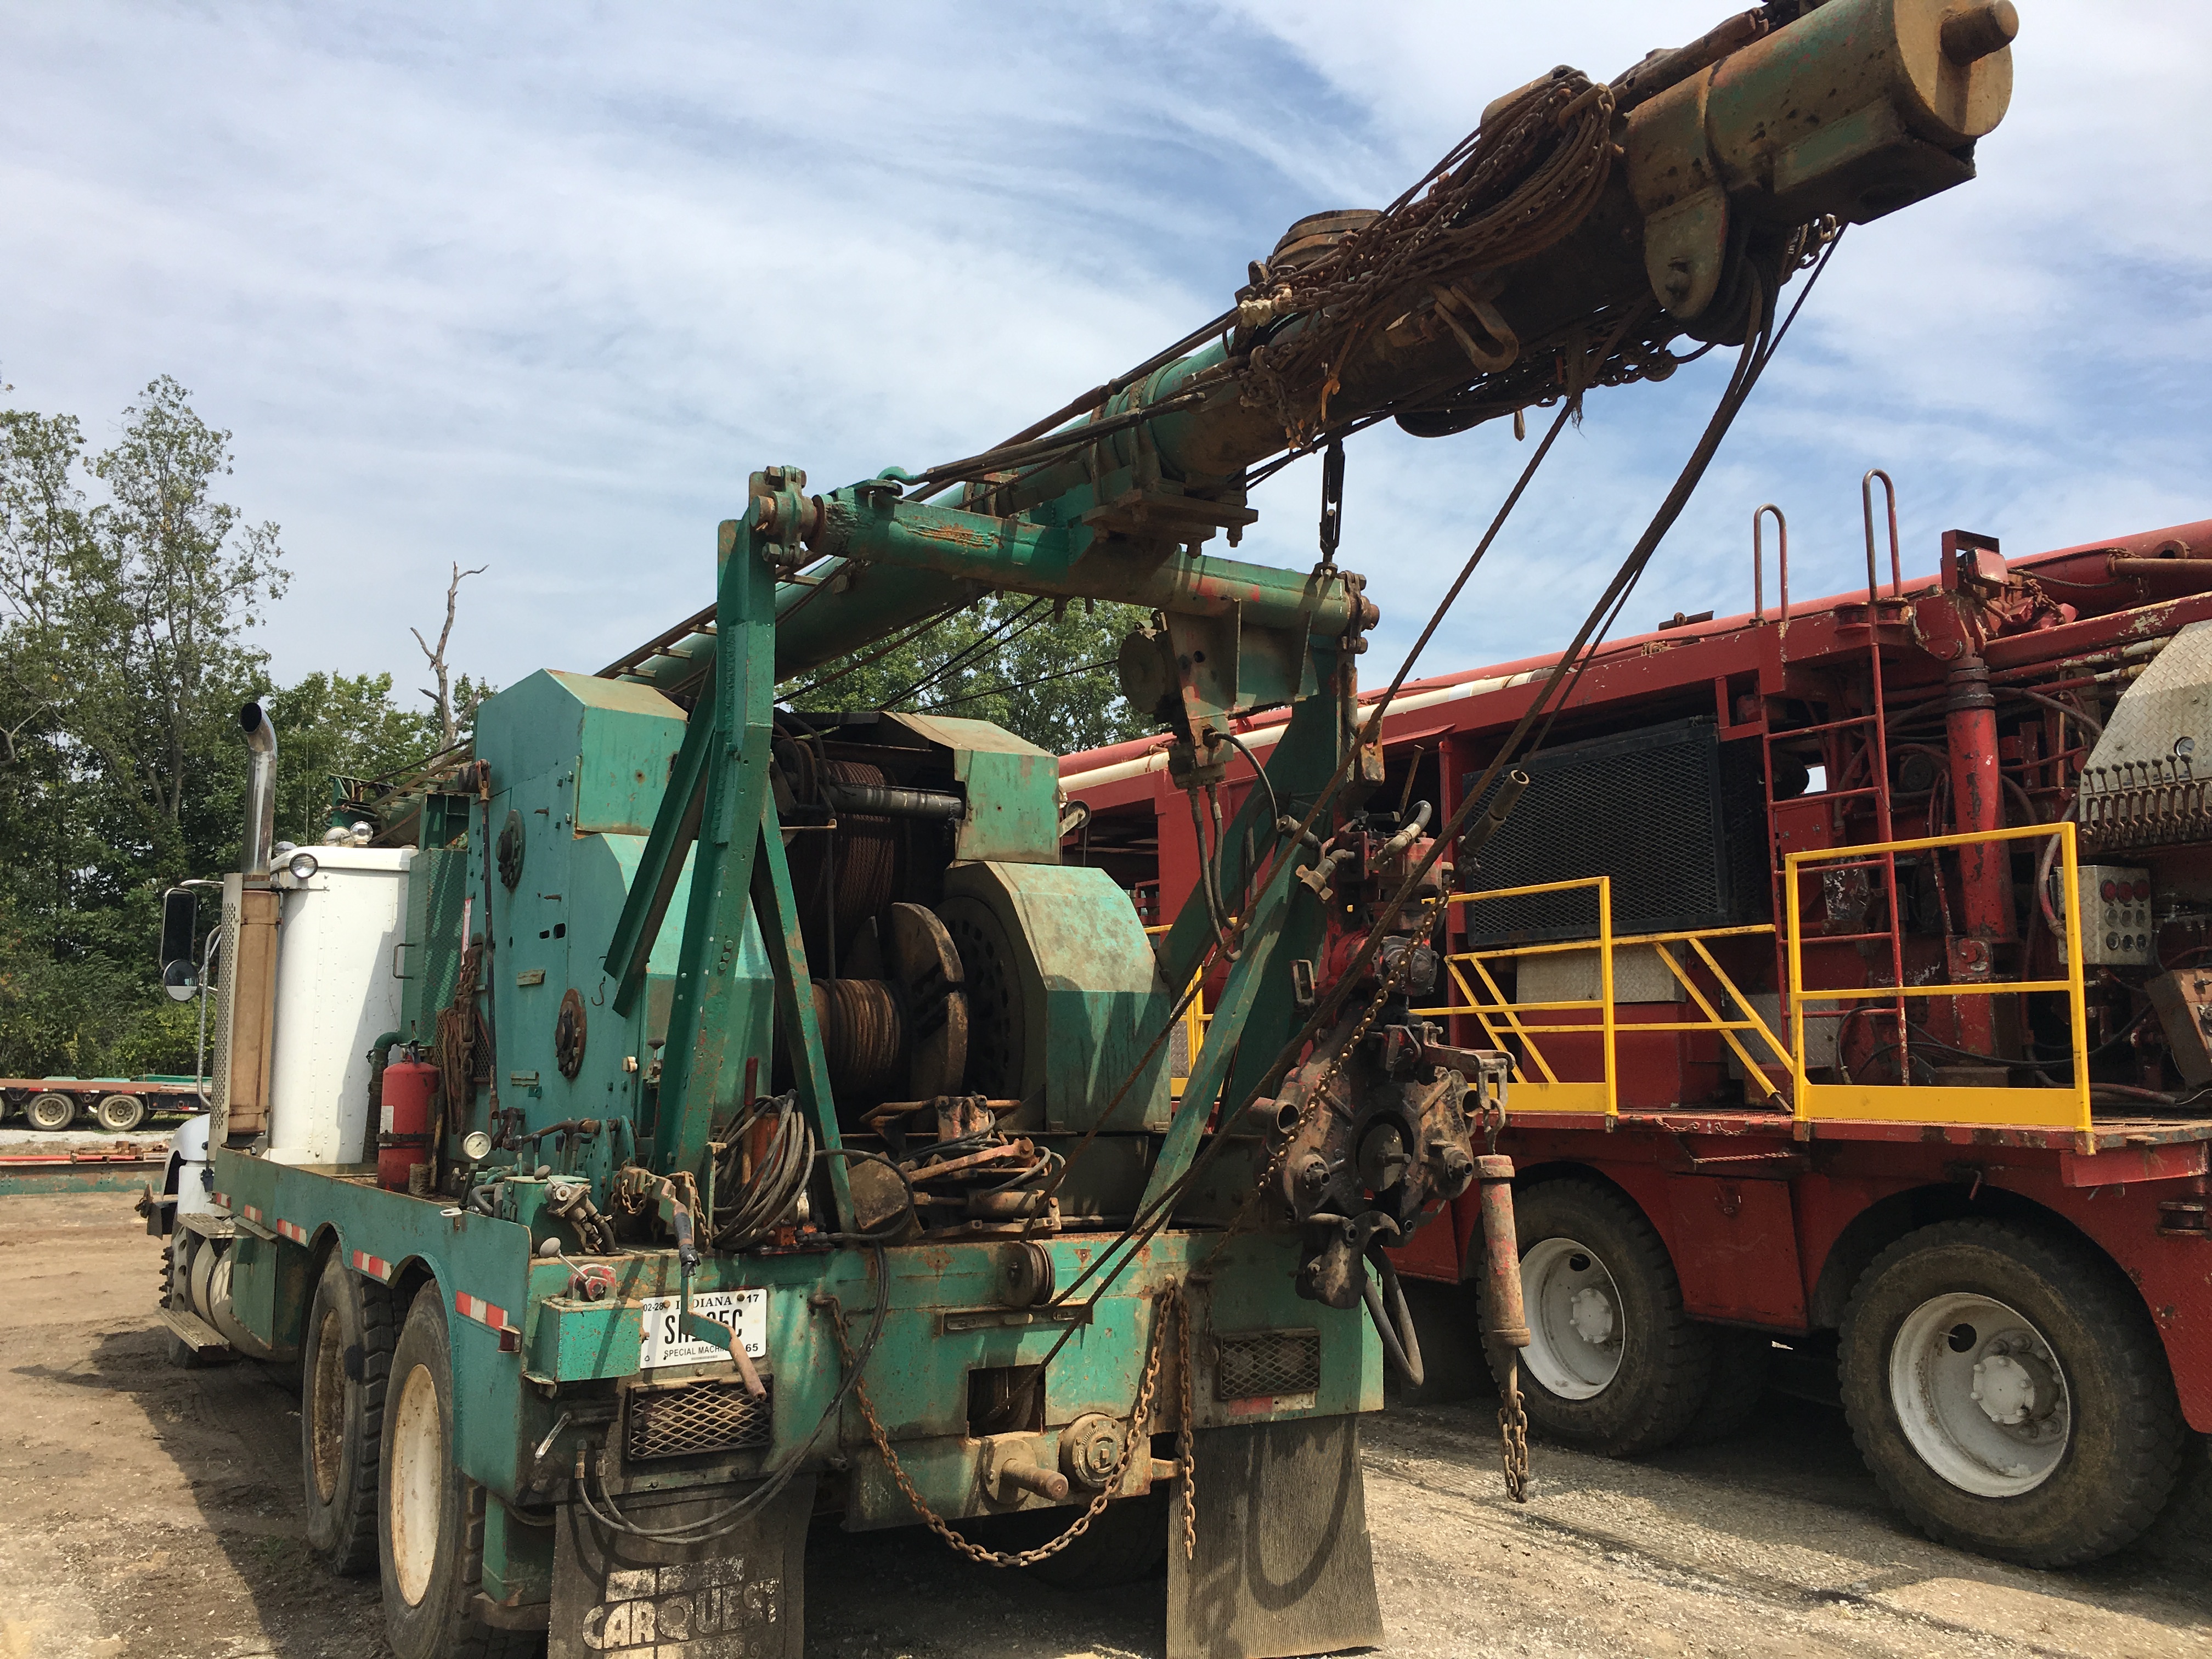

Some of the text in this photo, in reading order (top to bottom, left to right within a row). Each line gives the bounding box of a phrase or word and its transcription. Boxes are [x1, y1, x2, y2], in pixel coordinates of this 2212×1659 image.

[675, 1296, 732, 1310] IDIANA
[747, 1294, 759, 1303] 17
[644, 1302, 664, 1312] 02-28
[746, 1343, 759, 1352] 65
[664, 1348, 696, 1358] SPECIAL
[582, 1578, 781, 1650] CARQUEST
